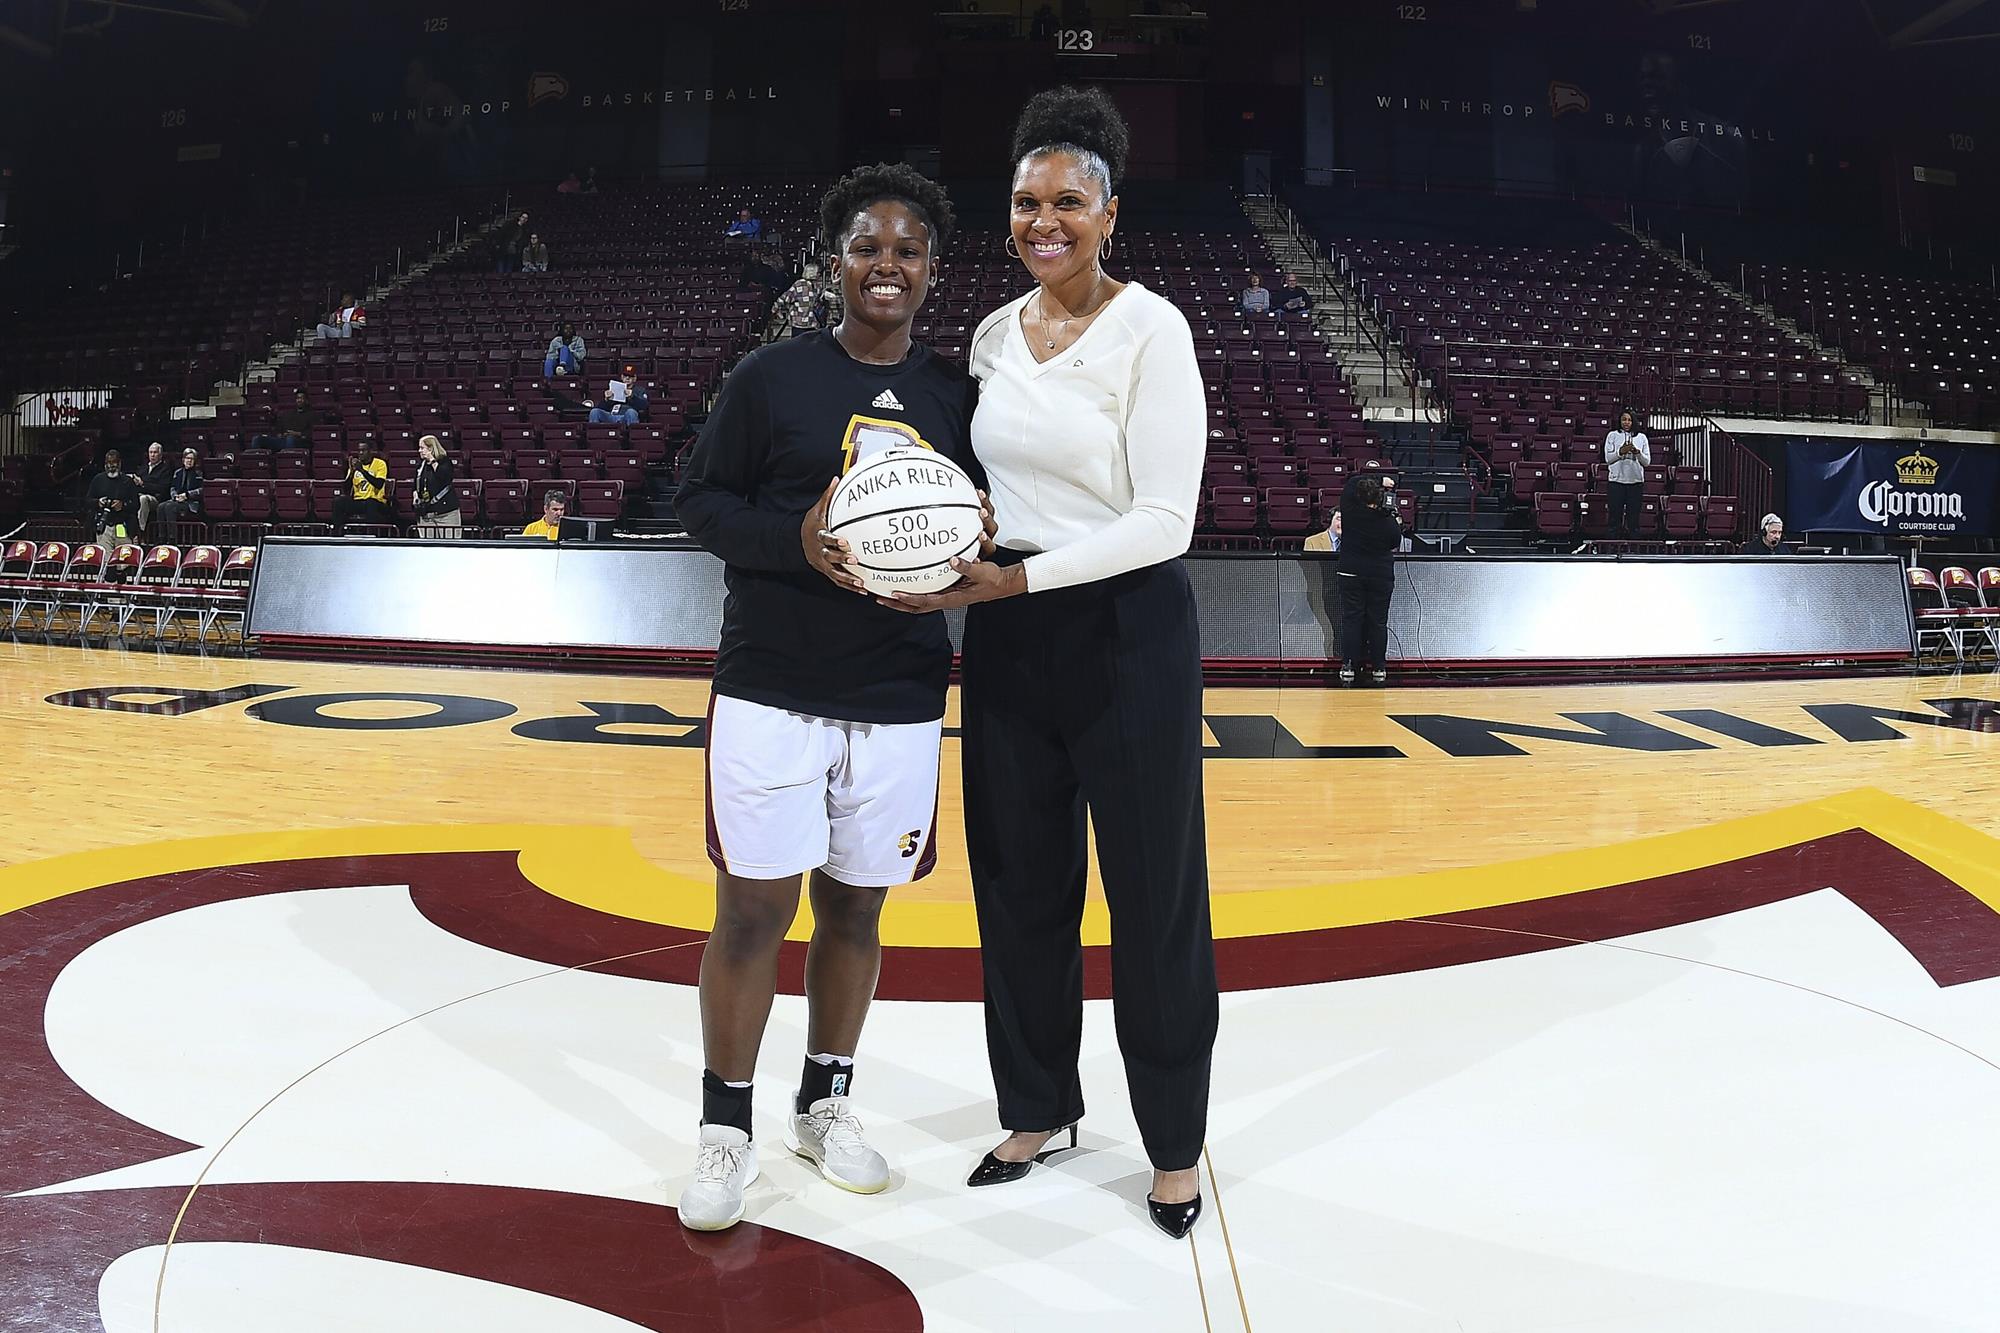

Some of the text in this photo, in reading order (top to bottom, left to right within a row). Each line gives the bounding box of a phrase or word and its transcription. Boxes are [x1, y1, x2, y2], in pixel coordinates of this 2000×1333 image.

[1396, 4, 1427, 21] 122
[423, 16, 448, 33] 125
[1053, 29, 1095, 50] 123
[1687, 33, 1712, 50] 121
[371, 88, 778, 122] WINTHROP BASKETBALL
[160, 108, 187, 128] 126
[1376, 95, 1776, 142] WINTHROP BASKETBALL
[1948, 133, 1974, 152] 120
[871, 400, 905, 411] adidas
[847, 467, 954, 507] ANIKA RILEY
[1858, 480, 1964, 527] Corona
[888, 513, 929, 535] 500
[1898, 522, 1956, 531] COURTSIDE CLUB
[861, 527, 959, 556] REBOUNDS
[871, 572, 920, 584] JANUARY
[937, 565, 953, 577] 20
